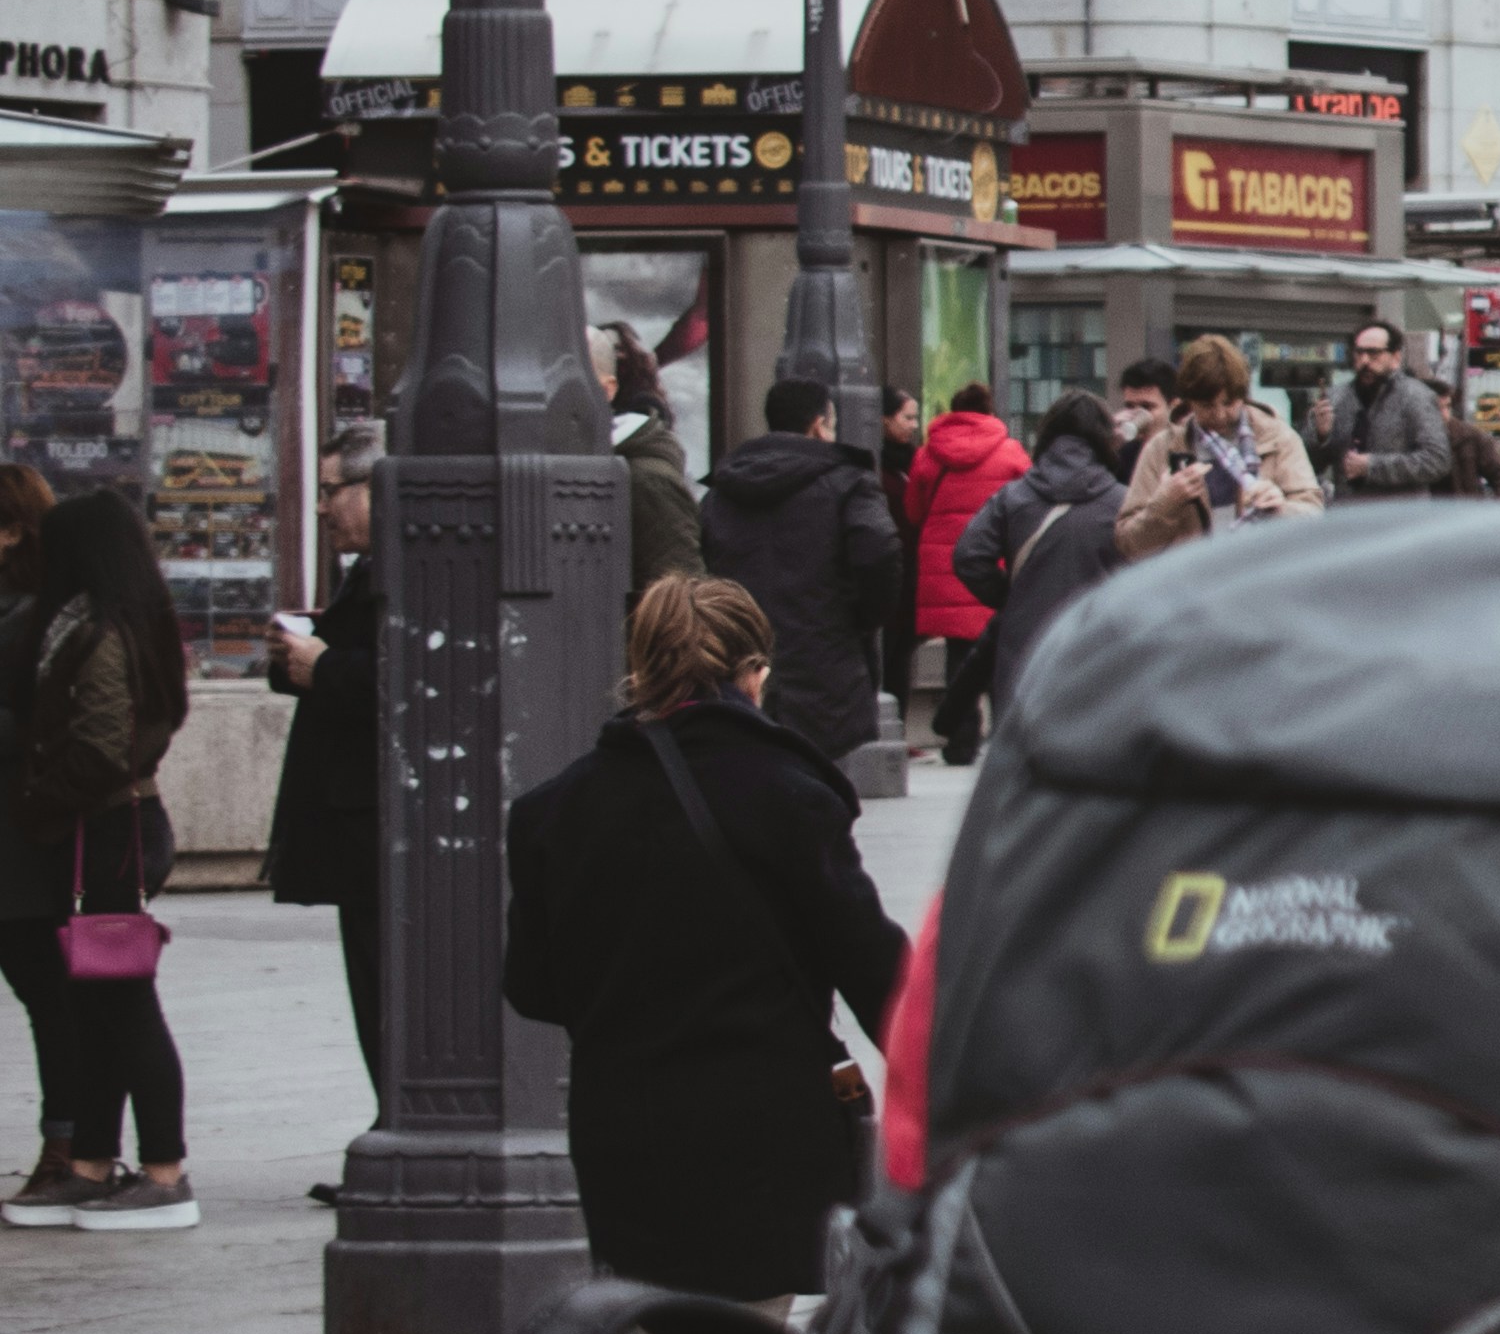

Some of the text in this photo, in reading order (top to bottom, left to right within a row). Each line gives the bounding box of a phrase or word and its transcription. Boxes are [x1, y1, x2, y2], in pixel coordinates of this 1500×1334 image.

[330, 79, 418, 116] OFFICIAL
[620, 135, 752, 167] TICKETS
[1228, 168, 1354, 222] TABACOS
[1227, 873, 1362, 919] NATIONAL
[1212, 911, 1396, 955] GEOGRAPHIC
